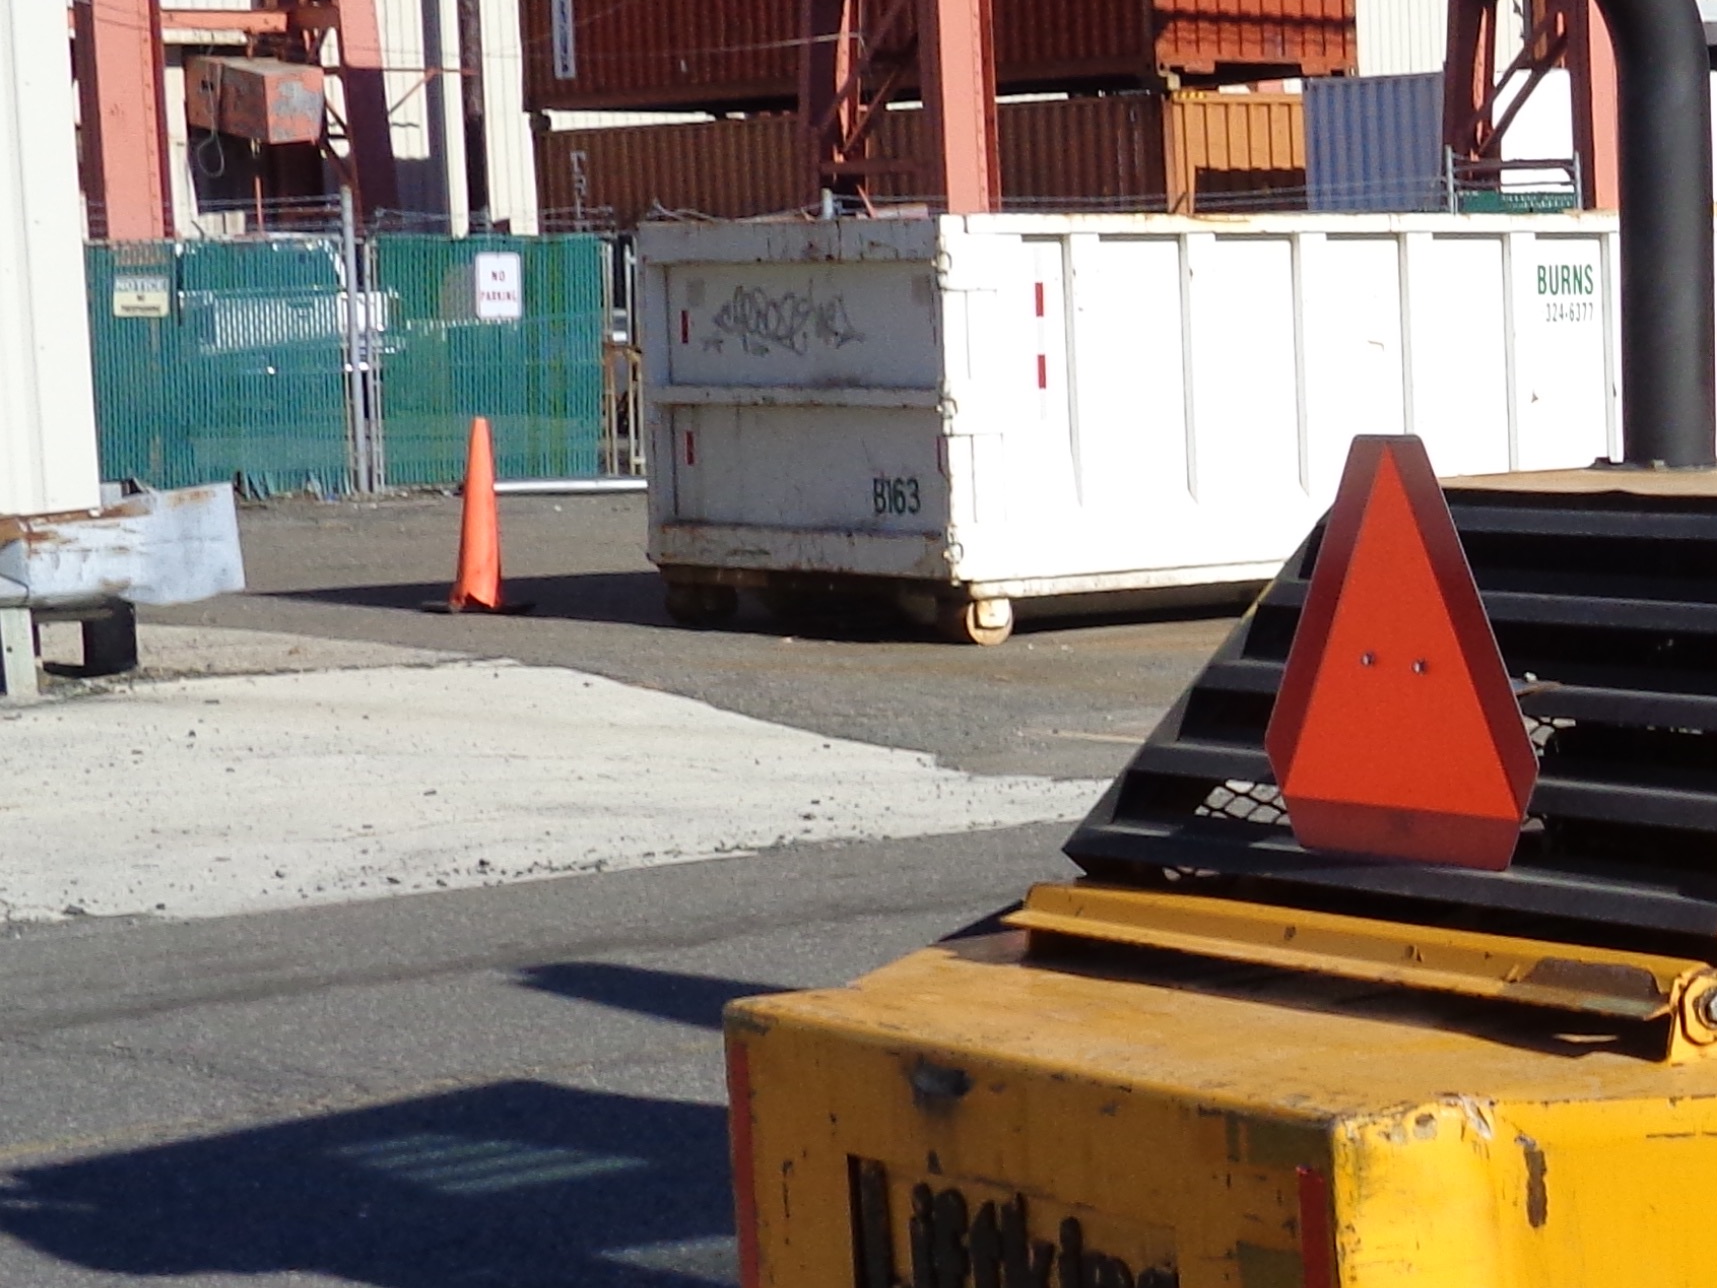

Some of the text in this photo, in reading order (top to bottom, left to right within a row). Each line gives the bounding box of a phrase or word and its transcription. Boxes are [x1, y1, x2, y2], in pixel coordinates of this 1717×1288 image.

[491, 270, 505, 282] NO
[1537, 264, 1594, 296] BURNS
[872, 477, 921, 515] B163
